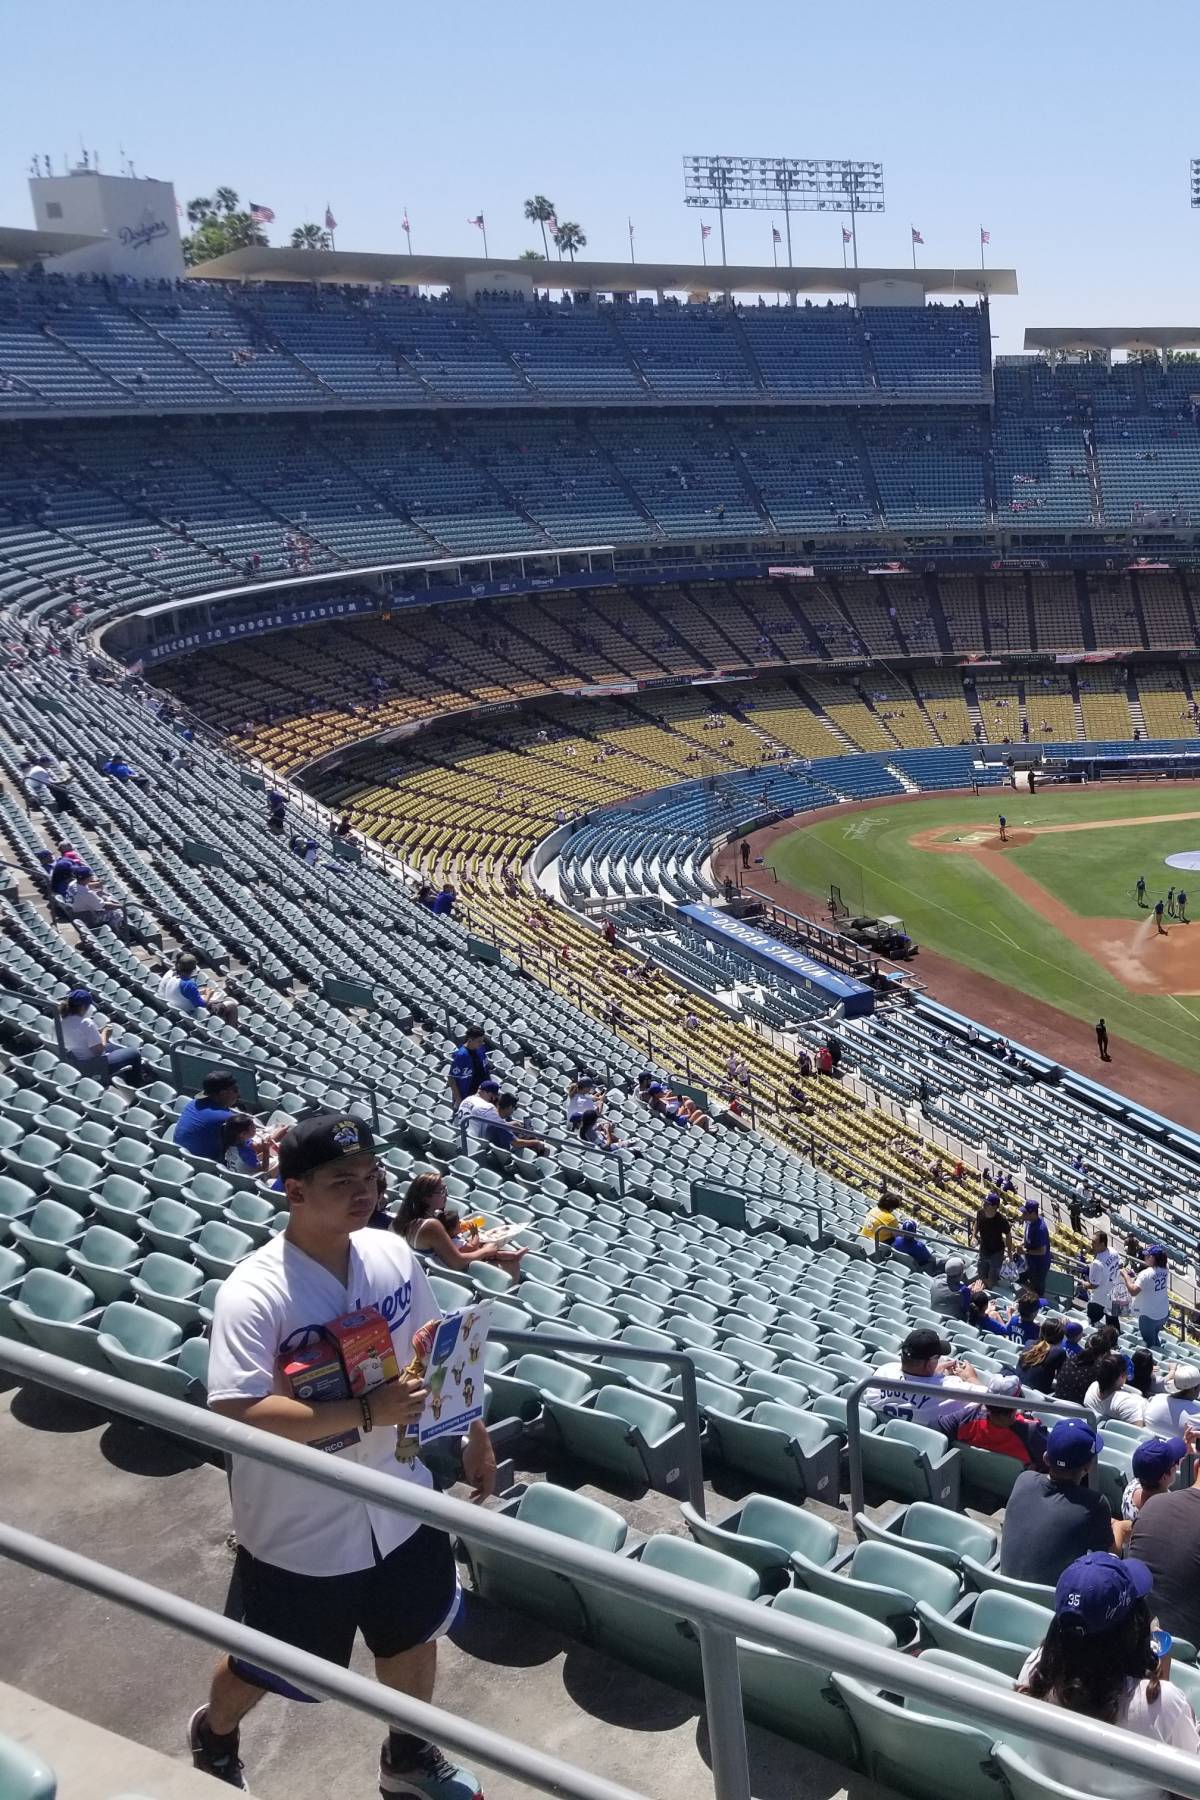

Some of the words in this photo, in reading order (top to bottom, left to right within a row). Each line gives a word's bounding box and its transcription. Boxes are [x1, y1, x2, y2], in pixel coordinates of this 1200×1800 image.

[229, 616, 282, 634] DODGER
[292, 603, 357, 621] STADIUM
[713, 918, 769, 946] DODGER
[766, 944, 830, 978] STADIUM
[1154, 1277, 1166, 1292] 22
[1067, 1593, 1081, 1606] 35
